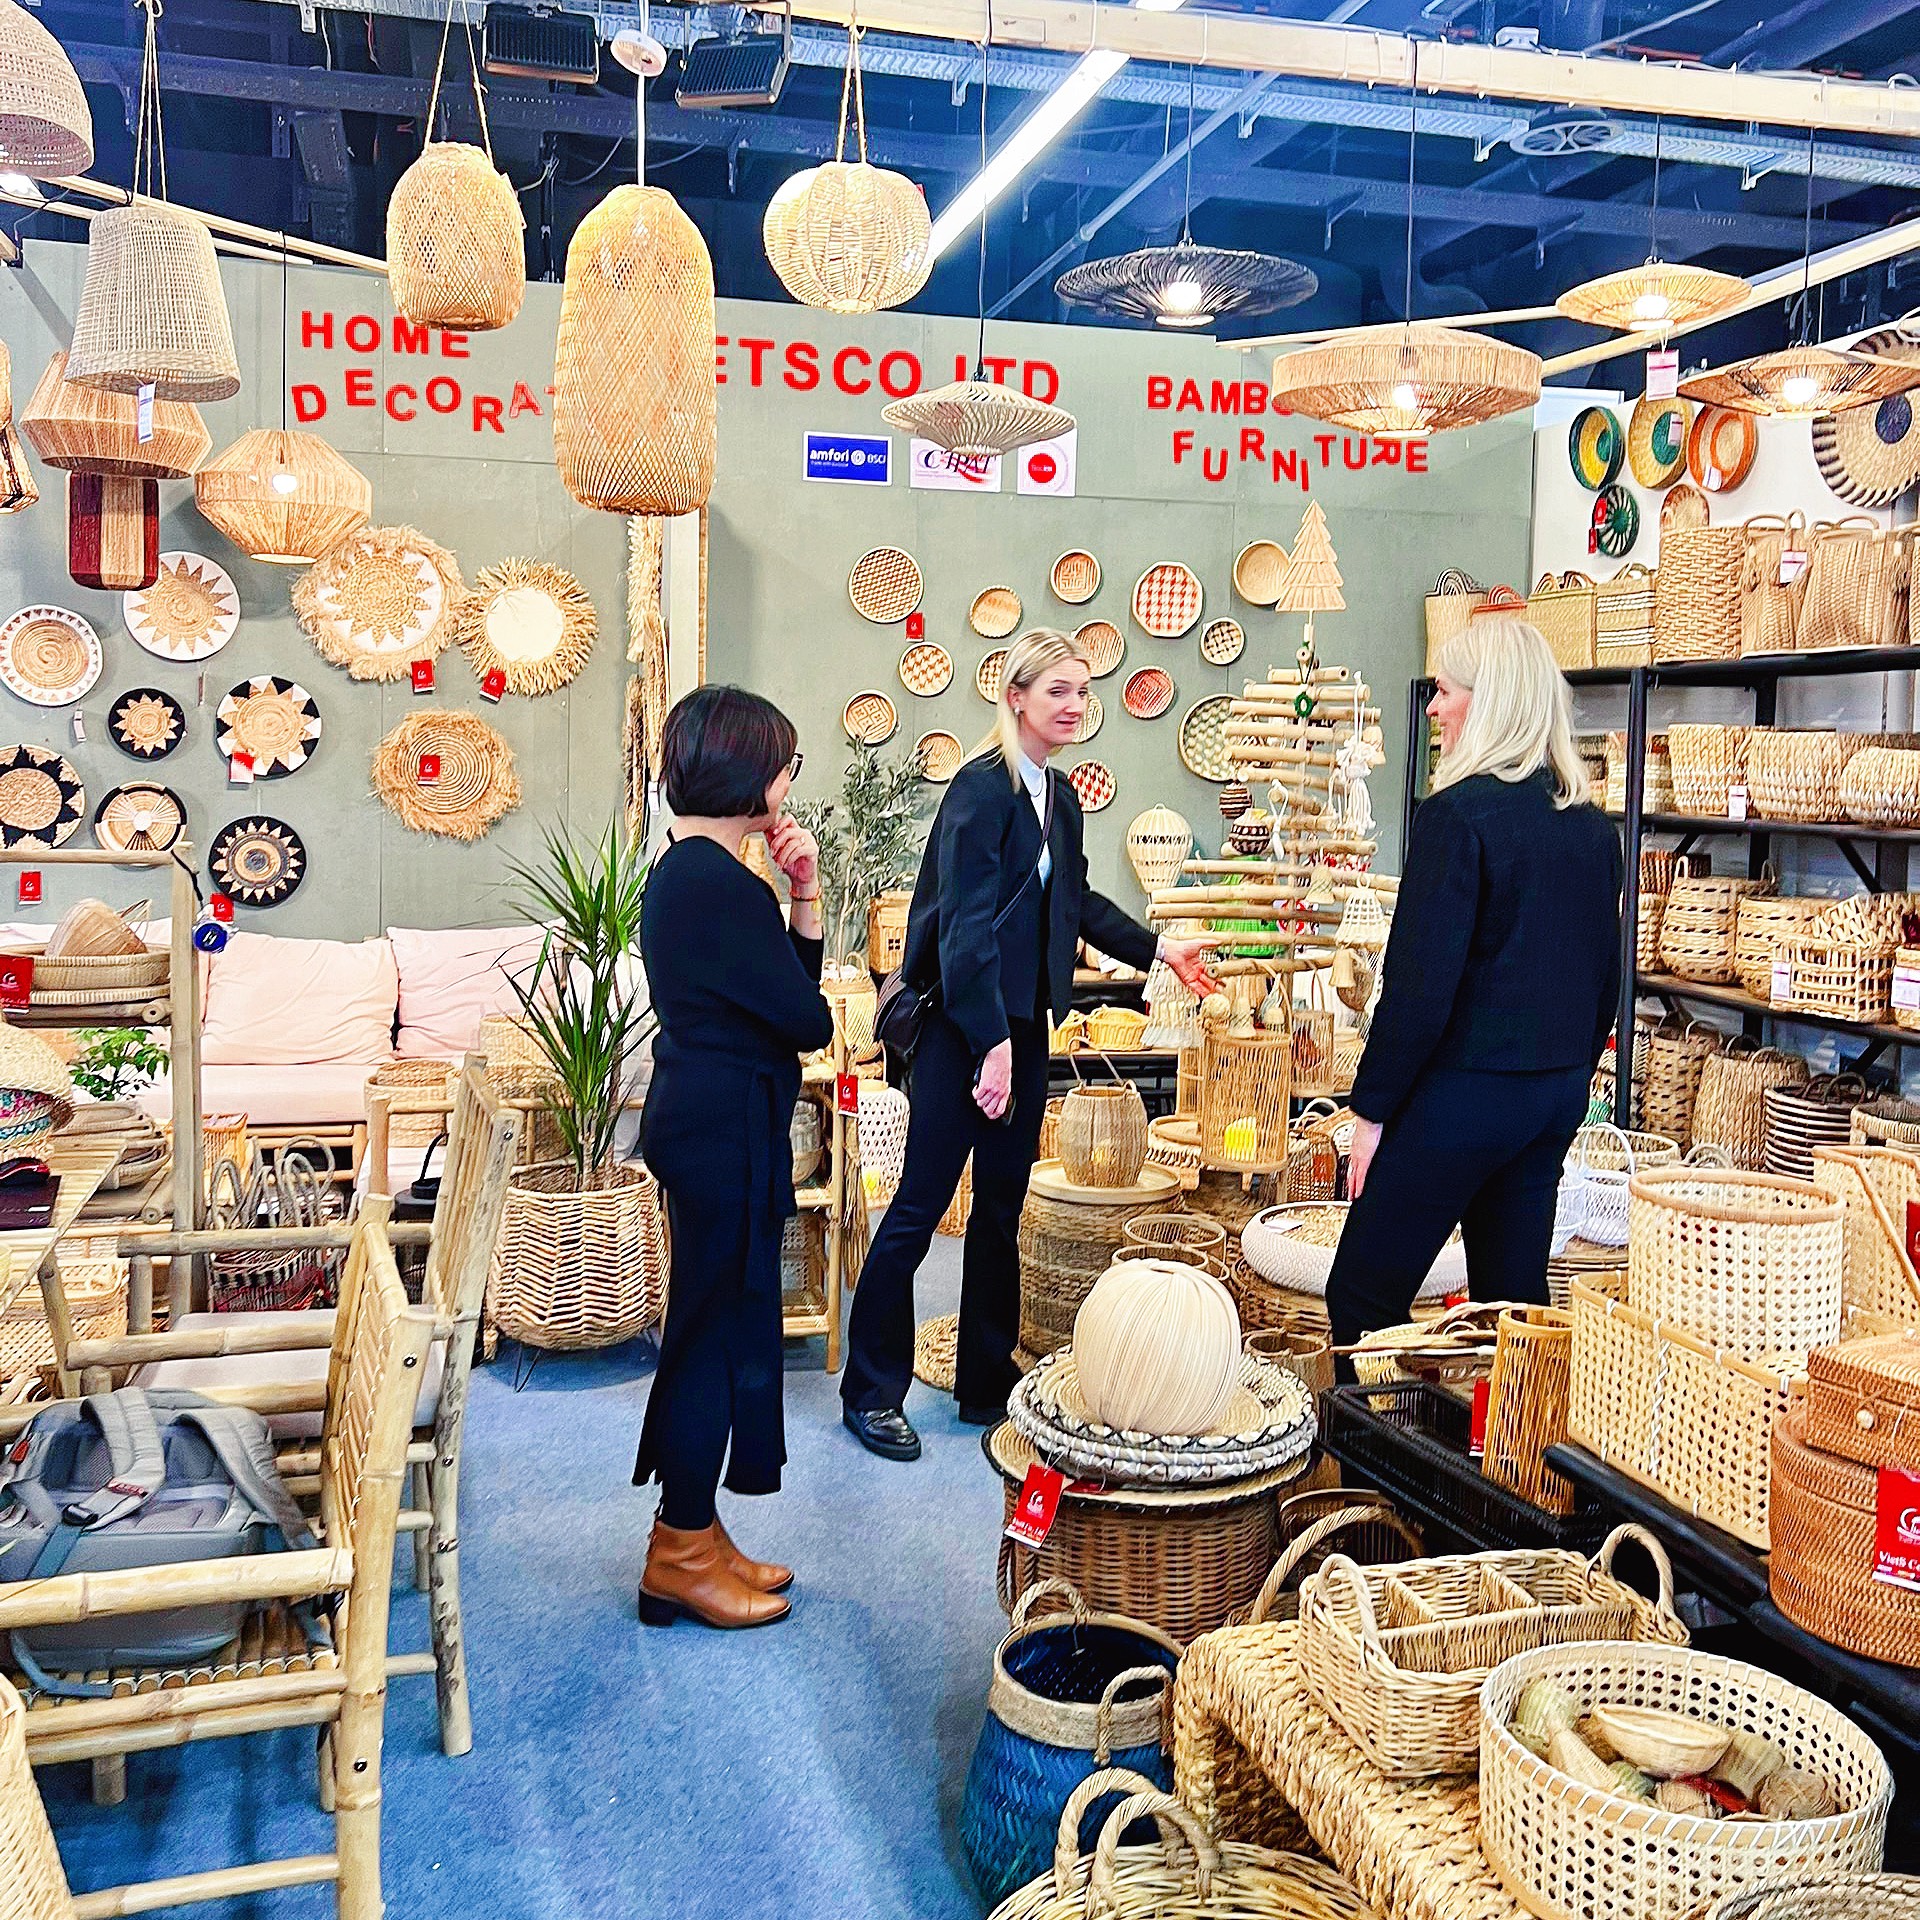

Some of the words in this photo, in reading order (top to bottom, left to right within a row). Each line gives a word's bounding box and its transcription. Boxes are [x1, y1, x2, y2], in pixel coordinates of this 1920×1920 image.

[301, 310, 471, 359] HOME
[291, 368, 555, 434] DECORA
[809, 447, 850, 462] amfori
[1173, 427, 1429, 492] FURNITURE
